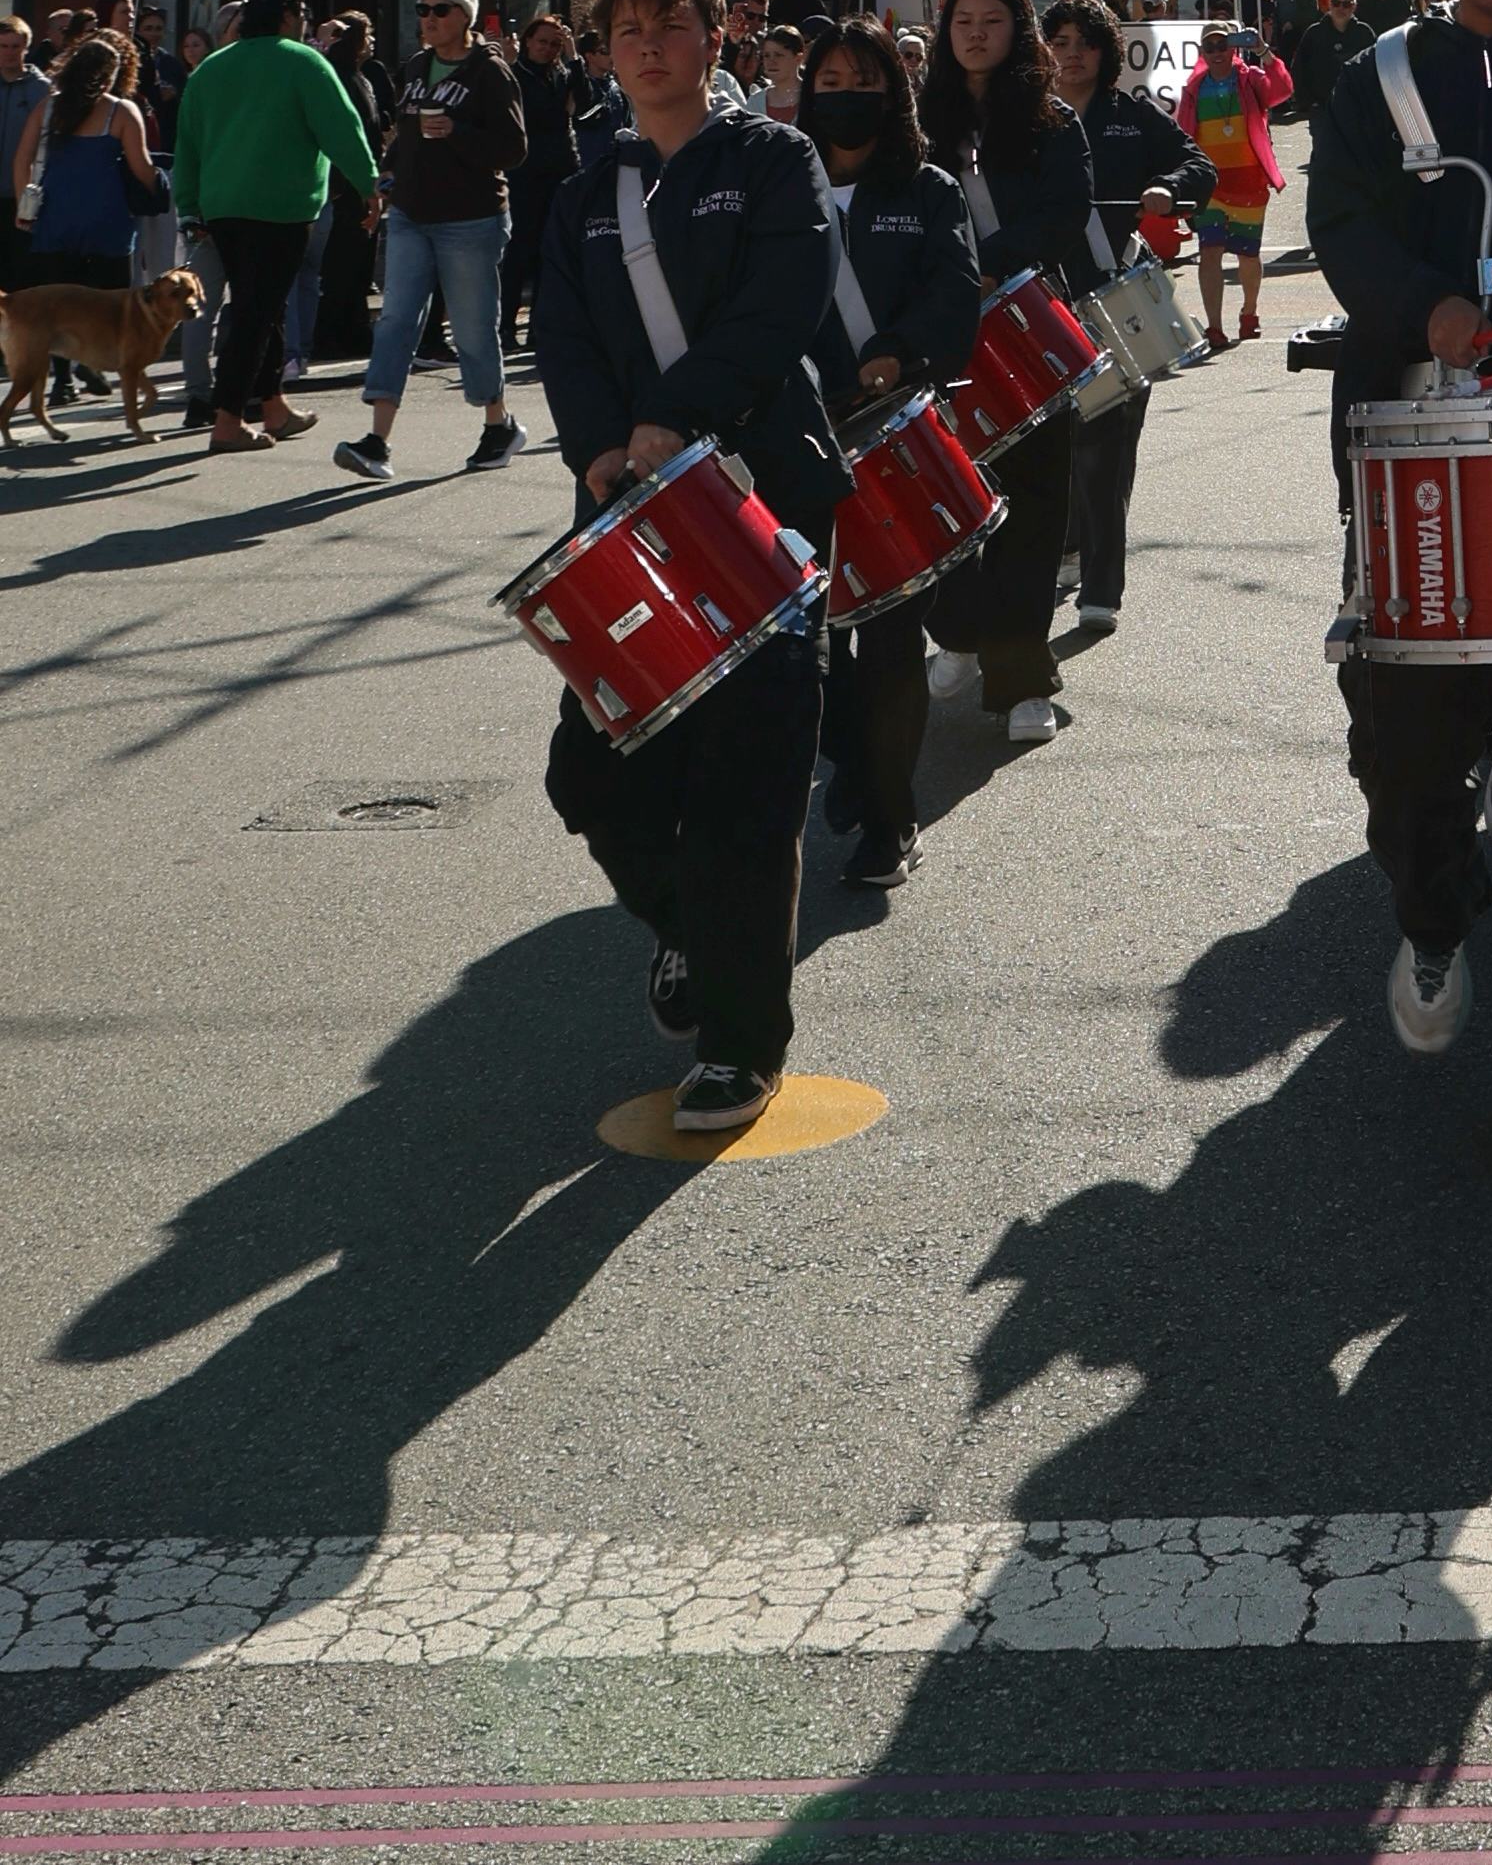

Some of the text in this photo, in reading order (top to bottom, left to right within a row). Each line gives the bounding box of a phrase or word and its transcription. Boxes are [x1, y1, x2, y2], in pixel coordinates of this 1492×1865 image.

[1127, 39, 1200, 72] OAD
[692, 202, 720, 217] DRUM
[871, 223, 896, 233] DRUM
[876, 214, 921, 225] LOWELL
[1417, 515, 1446, 627] YAMAHA
[618, 609, 642, 630] Adam
